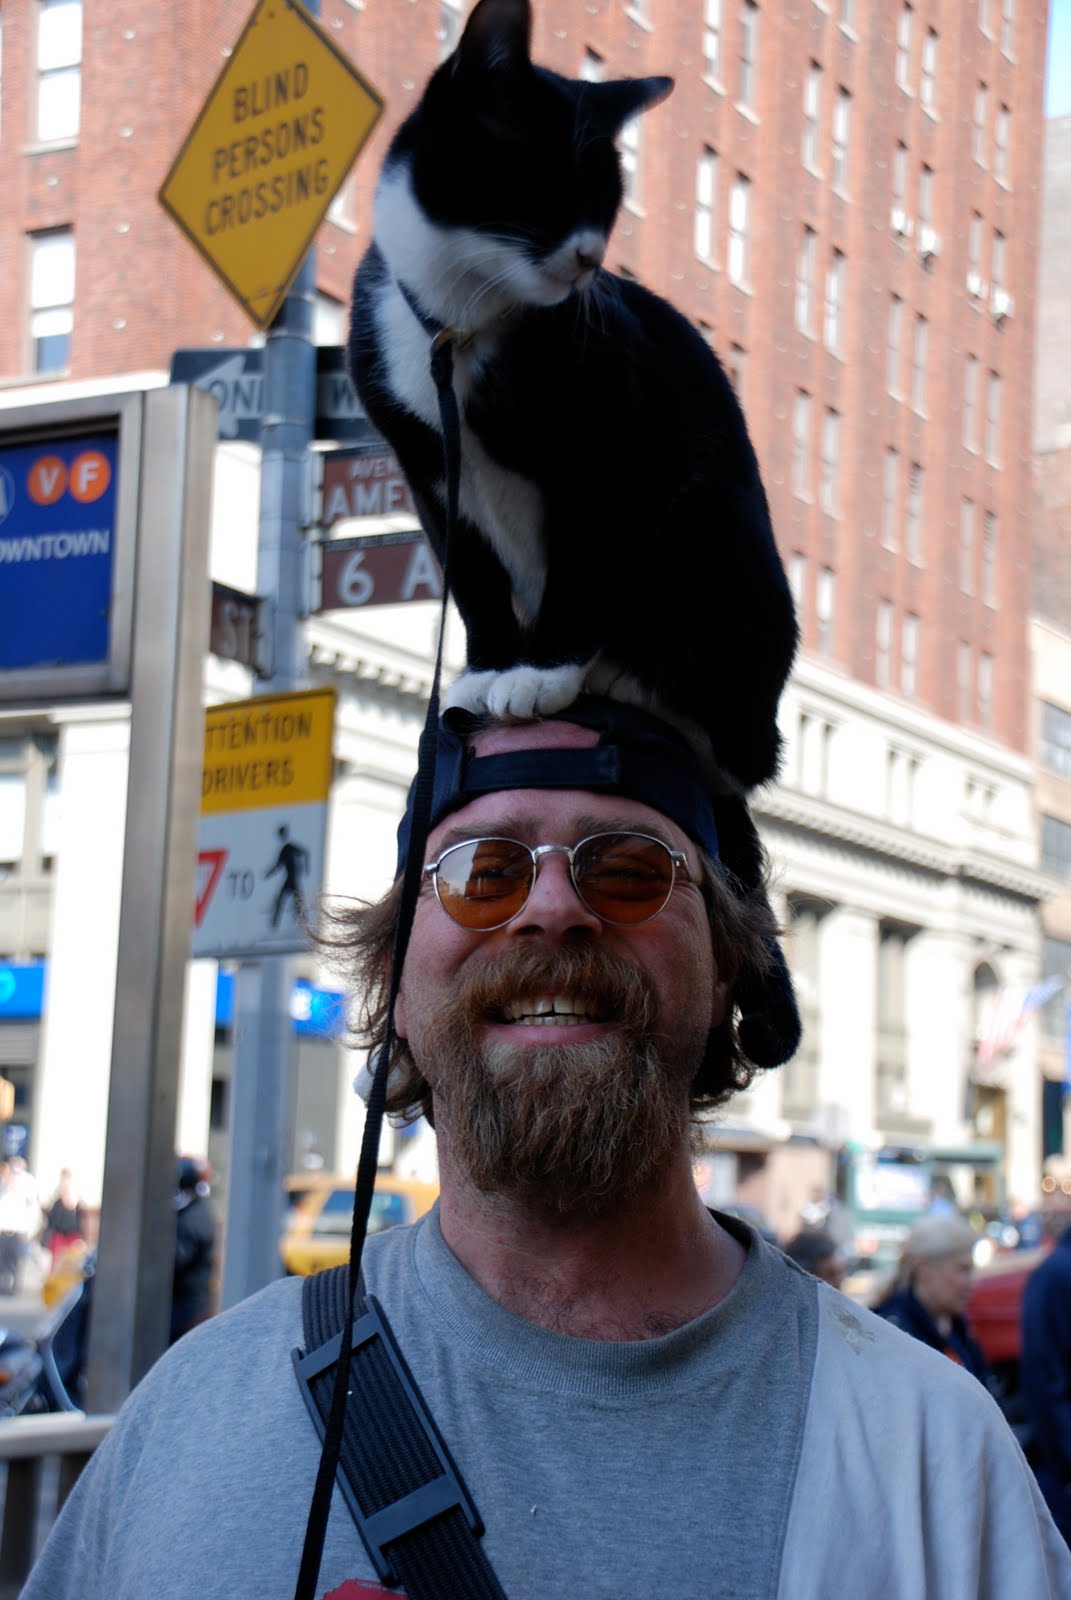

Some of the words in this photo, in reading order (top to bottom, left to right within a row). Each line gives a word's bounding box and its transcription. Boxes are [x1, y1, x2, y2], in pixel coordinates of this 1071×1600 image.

[232, 61, 309, 124] BLIND
[213, 107, 325, 184] PERSONS
[204, 159, 330, 237] CROSSING
[208, 378, 264, 411] ON
[38, 465, 60, 497] V
[78, 460, 100, 493] F
[338, 552, 374, 605] 6
[202, 759, 295, 796] DRIVERS
[227, 869, 255, 901] TO
